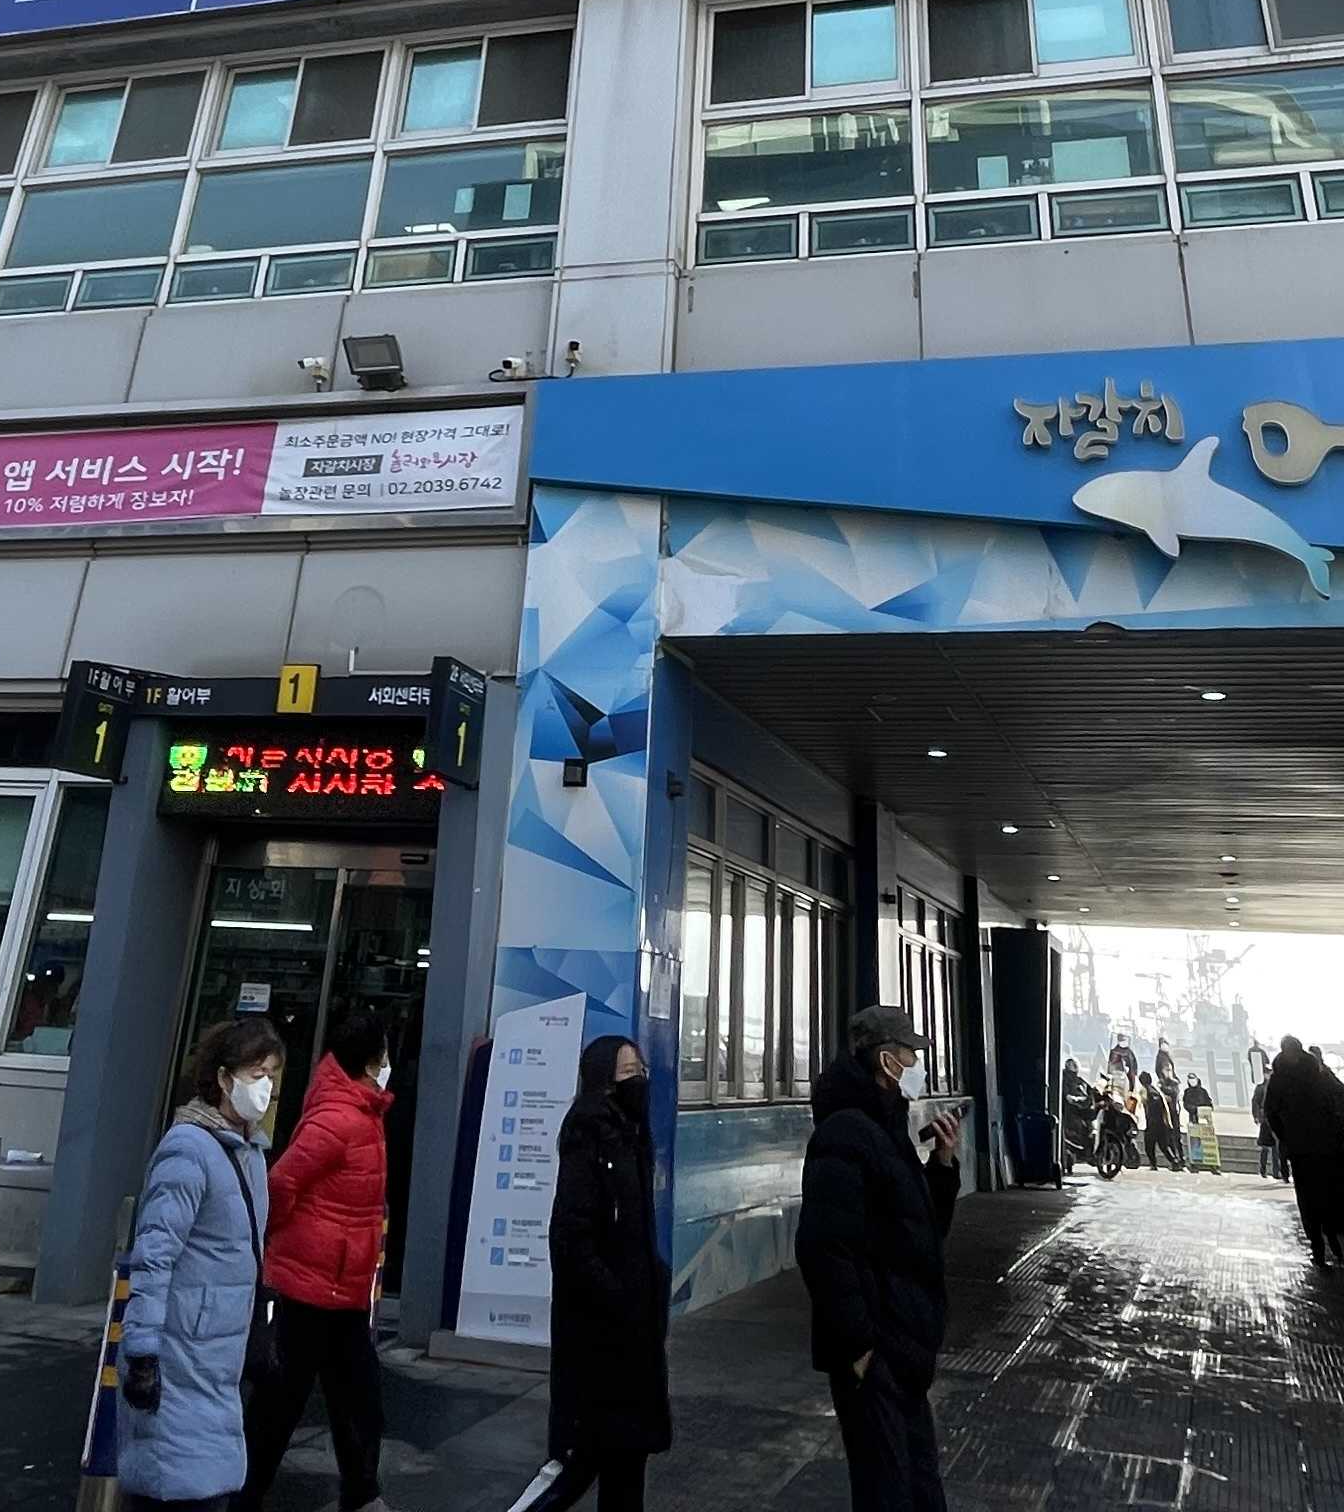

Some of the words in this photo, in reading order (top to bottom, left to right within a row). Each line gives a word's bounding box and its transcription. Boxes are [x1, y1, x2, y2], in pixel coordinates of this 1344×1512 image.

[285, 432, 367, 449] 최소주문금액
[371, 431, 397, 445] NO!
[401, 427, 457, 443] 현장가격
[460, 423, 510, 439] 그대로!
[1014, 377, 1186, 462] 자갈치
[4, 459, 36, 491] 앱
[44, 454, 148, 487] 서비스
[159, 448, 245, 482] 시작!
[4, 497, 44, 514] 10%
[49, 492, 124, 513] 저렴하게
[129, 489, 195, 509] 장보자!
[342, 483, 371, 499] 문의
[166, 687, 211, 706] 활어부
[95, 721, 107, 764] 1
[457, 721, 467, 767] 1
